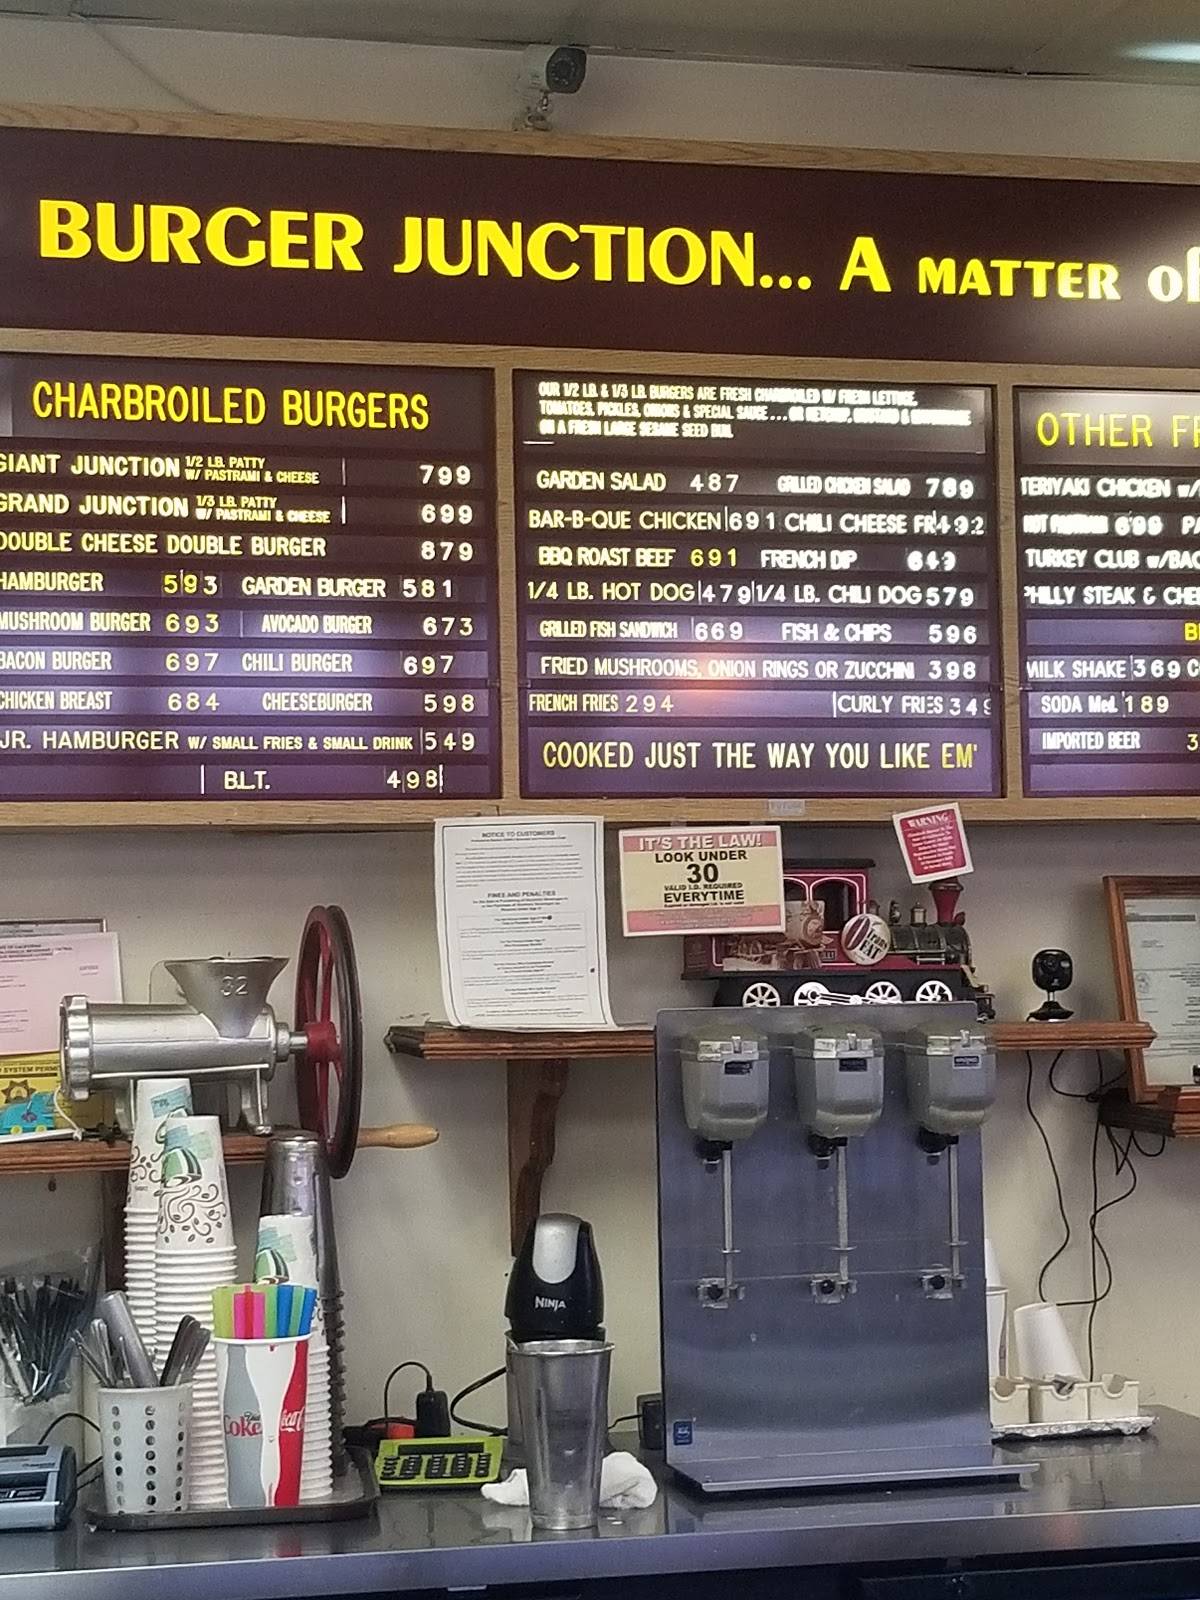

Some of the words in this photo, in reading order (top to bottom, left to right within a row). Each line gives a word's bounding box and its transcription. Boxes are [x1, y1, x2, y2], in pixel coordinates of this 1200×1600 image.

[39, 199, 364, 272] BURGER
[394, 216, 812, 291] JUNCTION...
[839, 236, 892, 293] A
[918, 256, 1121, 300] MATTER
[538, 381, 560, 397] OUR
[649, 385, 694, 400] BURGERS
[696, 386, 717, 401] ARE
[720, 386, 752, 402] FRESH
[33, 381, 267, 425] CHARBROILED
[281, 389, 429, 430] BURGERS
[1036, 412, 1153, 447] OTHER
[70, 455, 180, 478] JUNCTION
[185, 455, 203, 467] 1/2
[228, 456, 266, 469] PATTY
[184, 469, 201, 481] W/
[204, 469, 261, 482] PASTRAMI
[264, 471, 273, 482] &
[276, 471, 320, 485] CHEESE
[419, 464, 471, 486] 799
[536, 470, 605, 490] GARDEN
[610, 472, 667, 492] SALAD
[690, 473, 739, 492] 487
[926, 477, 974, 499] 789
[1020, 476, 1091, 496] TERIYAKI
[1096, 477, 1172, 498] CHICKEN
[78, 495, 189, 517] JUNCTION
[196, 495, 215, 507] 1/3
[241, 496, 277, 509] PATTY
[215, 508, 272, 522] PASTRAMI
[276, 510, 284, 522] &
[287, 510, 331, 524] CHEESE
[421, 503, 473, 525] 699
[528, 509, 632, 529] BAR-B-QUE
[639, 511, 722, 531] CHICKEN
[728, 511, 775, 531] 691
[784, 512, 832, 532] CHILI
[839, 513, 908, 533] CHEESE
[81, 533, 158, 554] CHEESE
[167, 534, 243, 555] DOUBLE
[251, 536, 326, 557] BURGER
[421, 541, 474, 562] 879
[538, 546, 573, 567] BBQ
[577, 547, 631, 567] ROAST
[635, 548, 677, 567] BEEF
[690, 548, 737, 567] 691
[760, 549, 826, 569] FRENCH
[830, 549, 858, 570] DIP
[1025, 549, 1088, 568] TURKEY
[1094, 549, 1140, 569] CLUB
[163, 574, 218, 595] 593
[242, 576, 311, 596] GARDEN
[317, 577, 386, 597] BURGER
[402, 578, 452, 598] 581
[527, 581, 558, 600] 1/4
[567, 581, 594, 600] LB.
[602, 582, 641, 601] HOT
[650, 583, 695, 602] DOG
[702, 584, 751, 605] 479
[756, 584, 786, 603] 1/4
[794, 584, 820, 604] LB.
[828, 585, 871, 604] CHILI
[878, 585, 923, 604] DOG
[925, 586, 974, 607] 579
[1083, 586, 1136, 605] STEAK
[1143, 586, 1157, 605] &
[90, 612, 151, 632] BURGER
[165, 613, 219, 634] 693
[261, 614, 319, 633] AVOCADO
[322, 615, 373, 634] BURGER
[422, 617, 473, 636] 673
[539, 620, 587, 638] GRILLED
[590, 621, 616, 638] FISH
[619, 621, 678, 639] SANDWICH
[695, 622, 743, 641] 669
[782, 622, 819, 641] FISH
[823, 623, 840, 642] &
[844, 623, 892, 643] CHIPS
[929, 624, 977, 644] 596
[52, 651, 112, 671] BURGER
[165, 653, 219, 671] 697
[242, 653, 284, 672] CHILI
[291, 653, 353, 673] BURGER
[403, 656, 454, 675] 697
[540, 656, 588, 676] FRIED
[594, 657, 702, 678] MUSHROOMS,
[708, 659, 756, 678] ONION
[762, 660, 809, 679] RINGS
[815, 660, 838, 679] OR
[844, 660, 915, 679] ZUCCHINI
[928, 660, 976, 680] 398
[1072, 660, 1126, 679] SHAKE
[1133, 659, 1181, 678] 369
[60, 691, 112, 710] BREAST
[168, 692, 220, 712] 684
[262, 692, 373, 712] CHEESEBURGER
[424, 694, 475, 713] 598
[529, 693, 578, 712] FRENCH
[582, 694, 618, 712] FRIES
[625, 695, 674, 713] 294
[837, 695, 893, 713] CURLY
[901, 695, 944, 714] FRIES
[1041, 695, 1083, 713] SODA
[1124, 695, 1170, 713] 189
[0, 730, 32, 749] JR.
[43, 731, 179, 750] HAMBURGER
[188, 736, 207, 750] W/
[212, 736, 259, 750] SMALL
[263, 736, 303, 750] FRIES
[308, 736, 318, 750] &
[323, 736, 368, 750] SMALL
[373, 736, 413, 750] DRINK
[424, 732, 475, 751] 549
[1042, 731, 1104, 750] IMPORTED
[1108, 731, 1141, 749] BEER
[543, 741, 634, 768] COOKED
[644, 742, 701, 769] JUST
[711, 742, 757, 769] THE
[766, 742, 815, 769] WAY
[825, 742, 869, 769] YOU
[880, 742, 930, 769] LIKE
[941, 743, 978, 769] EM'
[386, 770, 438, 789] 498
[639, 836, 673, 851] IT'S
[677, 835, 713, 850] THE
[718, 833, 763, 848] LAW!
[655, 851, 694, 863] LOOK
[698, 850, 748, 862] UNDER
[686, 863, 719, 884] 30
[663, 889, 744, 903] EVERYTIME
[664, 883, 686, 891] VALID
[703, 882, 743, 890] REQUIRED
[221, 975, 249, 997] 32
